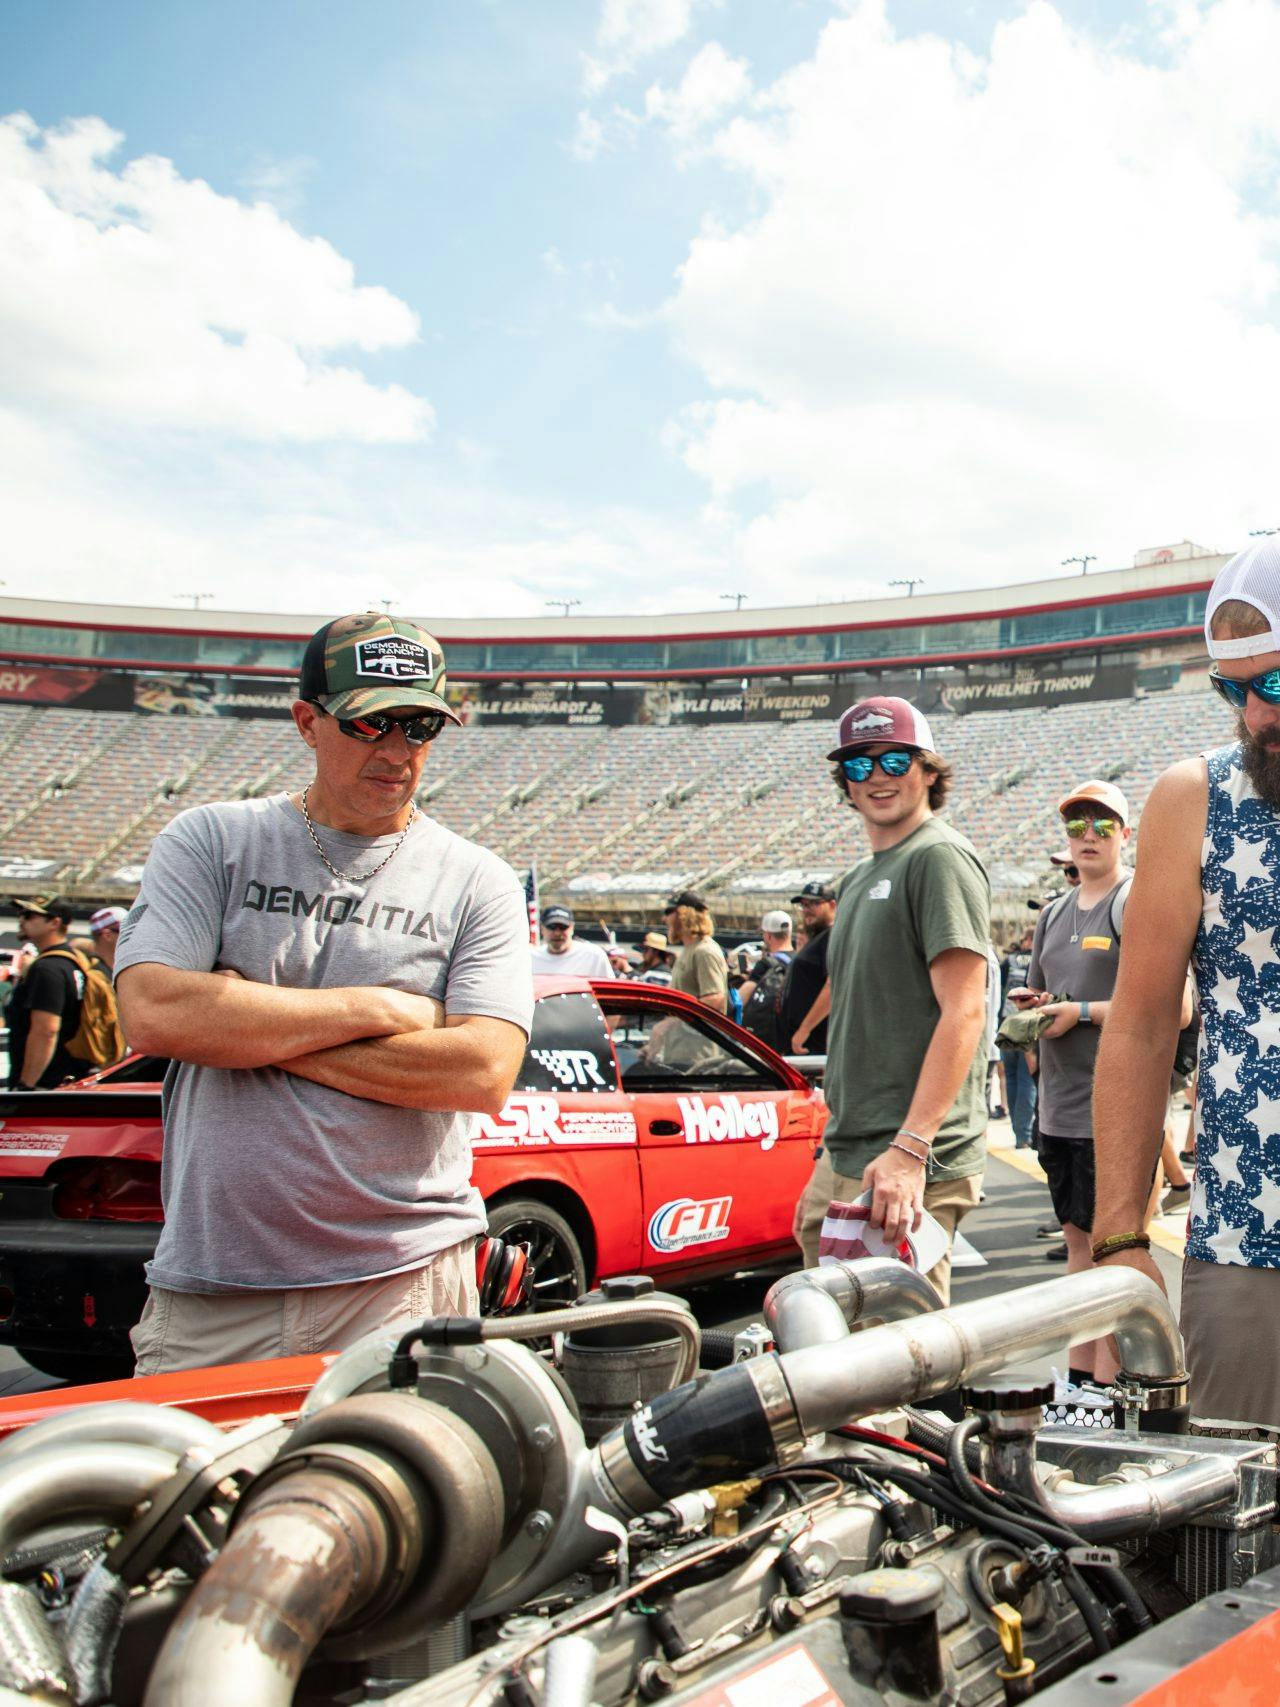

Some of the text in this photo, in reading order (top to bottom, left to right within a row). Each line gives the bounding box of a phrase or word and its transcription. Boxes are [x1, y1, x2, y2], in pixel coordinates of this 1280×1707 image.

[364, 643, 424, 653] DEMOLITION
[378, 648, 414, 656] RANCH
[946, 674, 1094, 700] TONY HELMET THROW
[462, 700, 499, 714] DALE
[502, 700, 584, 714] EARNHARDT
[763, 695, 830, 709] WEEKEND
[242, 880, 438, 942] DEMOLITIA
[677, 1095, 779, 1150] Holley
[668, 1200, 730, 1237] FTI
